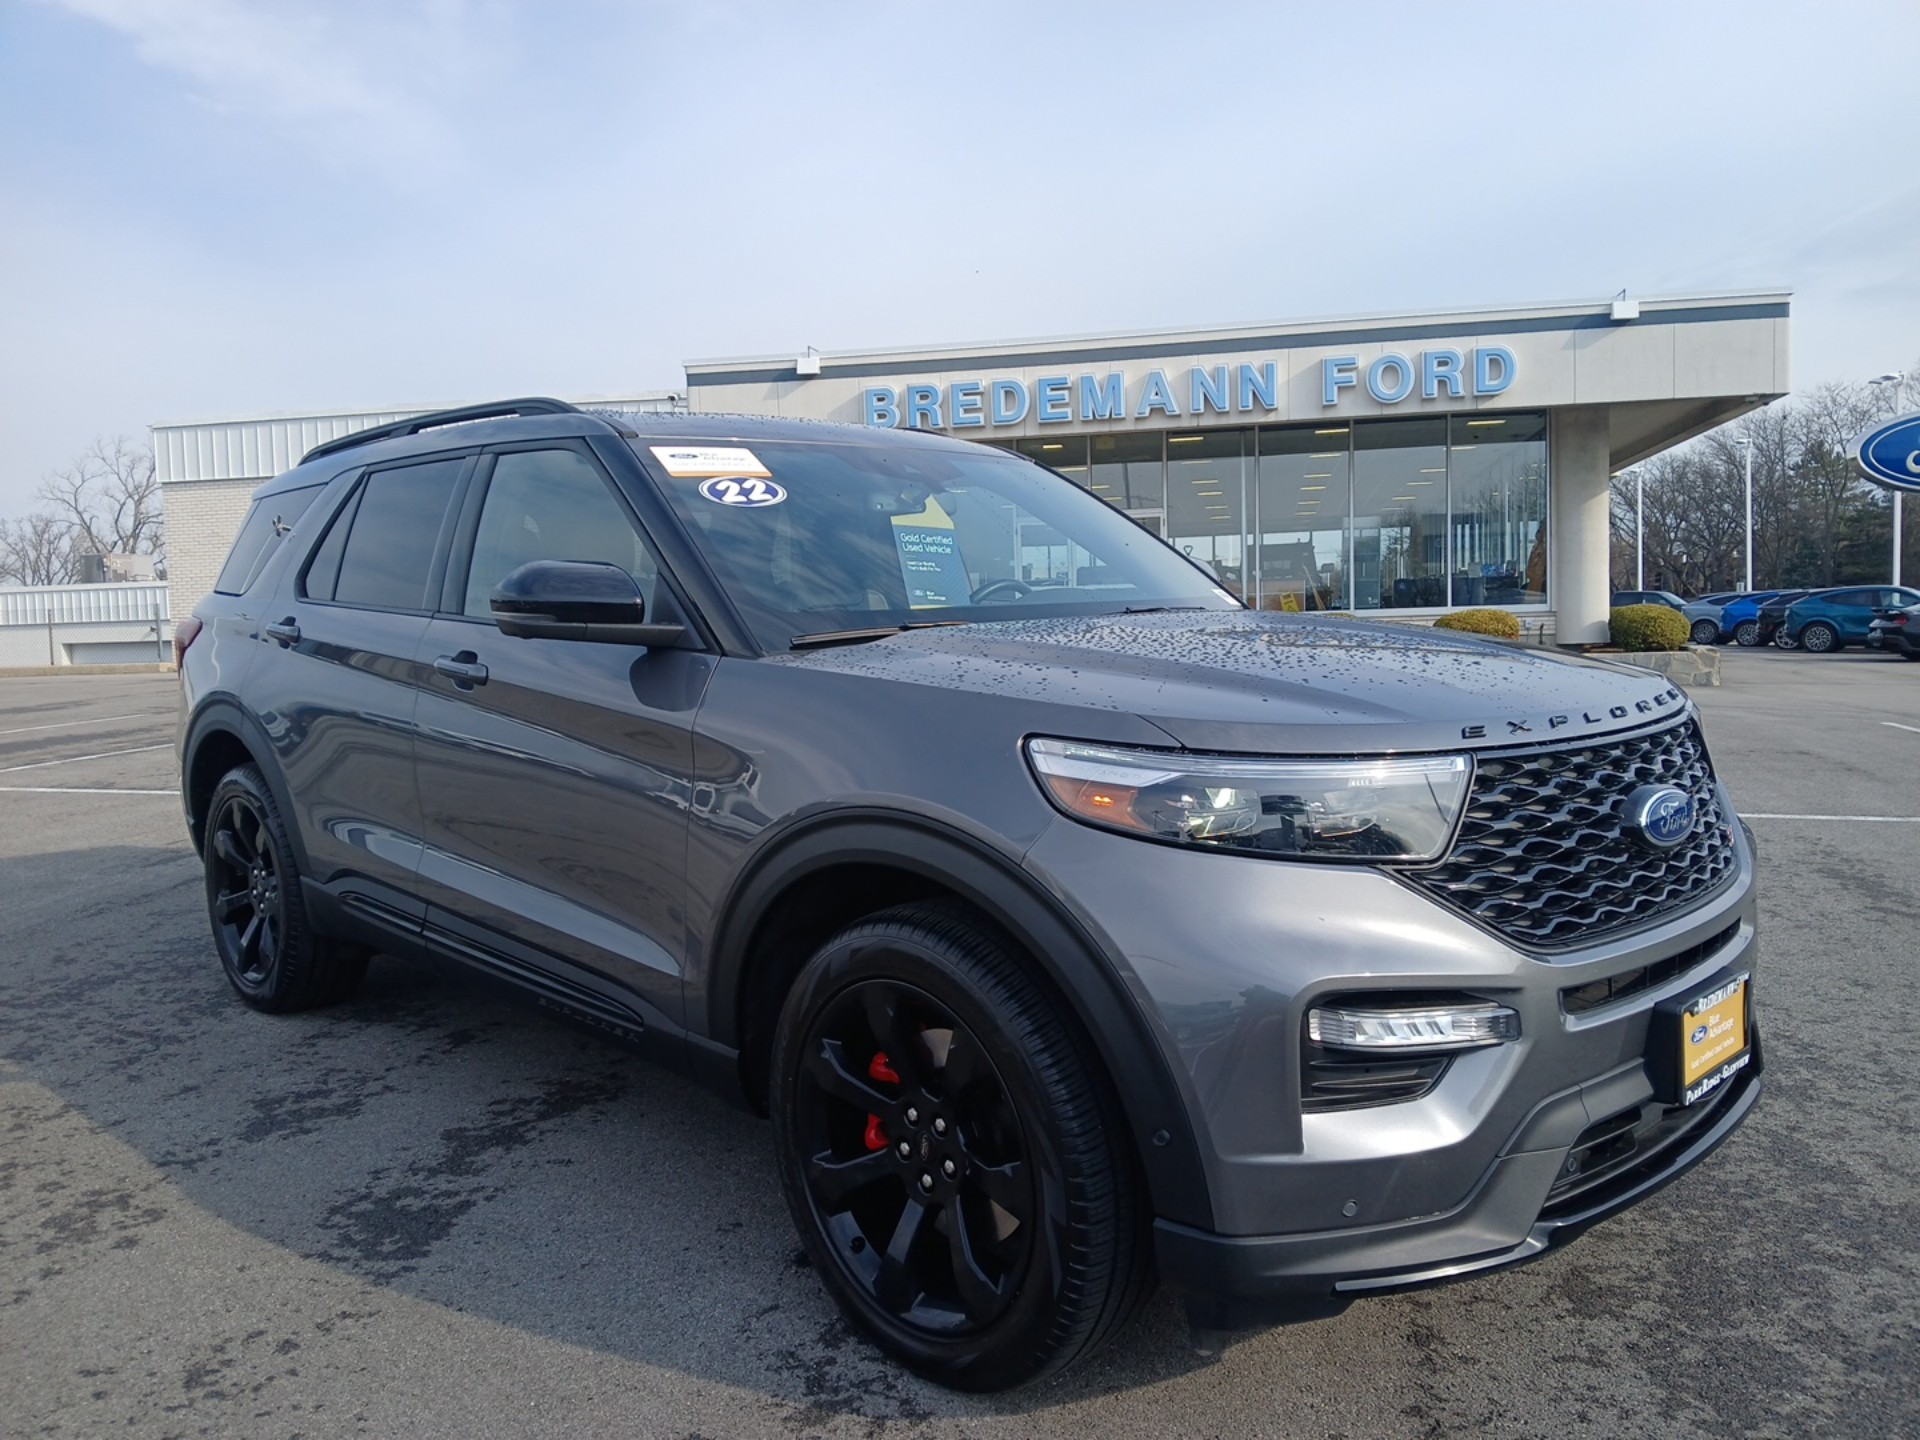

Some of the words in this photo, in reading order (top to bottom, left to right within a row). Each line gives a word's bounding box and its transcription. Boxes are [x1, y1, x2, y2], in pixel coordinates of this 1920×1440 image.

[862, 360, 1278, 429] BREDEMANN
[1321, 345, 1518, 406] FORD
[715, 478, 774, 503] 22
[900, 533, 920, 543] Gold
[921, 534, 953, 545] Certified
[902, 543, 923, 553] Used
[924, 544, 952, 554] Vehicle
[1461, 689, 1680, 739] EXPLORER
[1660, 800, 1690, 834] Ford
